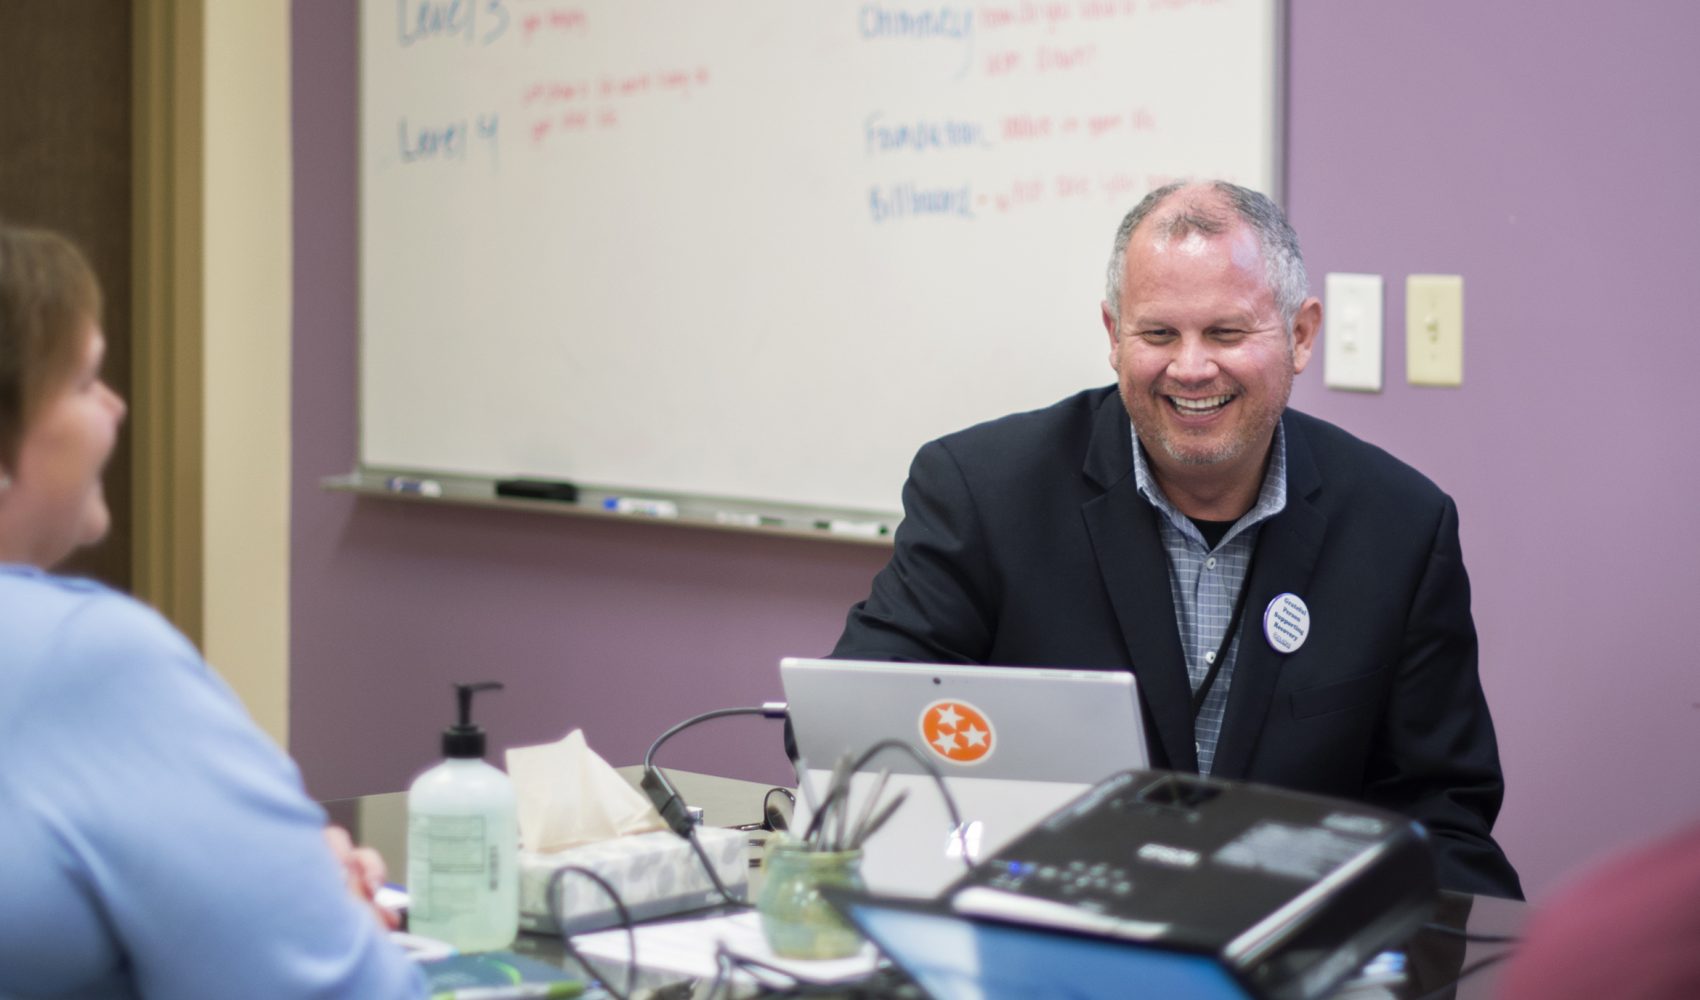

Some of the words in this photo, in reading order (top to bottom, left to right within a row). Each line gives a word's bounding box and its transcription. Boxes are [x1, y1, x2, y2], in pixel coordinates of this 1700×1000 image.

[397, 114, 468, 163] Level
[1282, 606, 1301, 622] Person
[1284, 597, 1307, 616] Grateful
[1273, 611, 1304, 636] Supporting
[1273, 622, 1298, 642] Recovery
